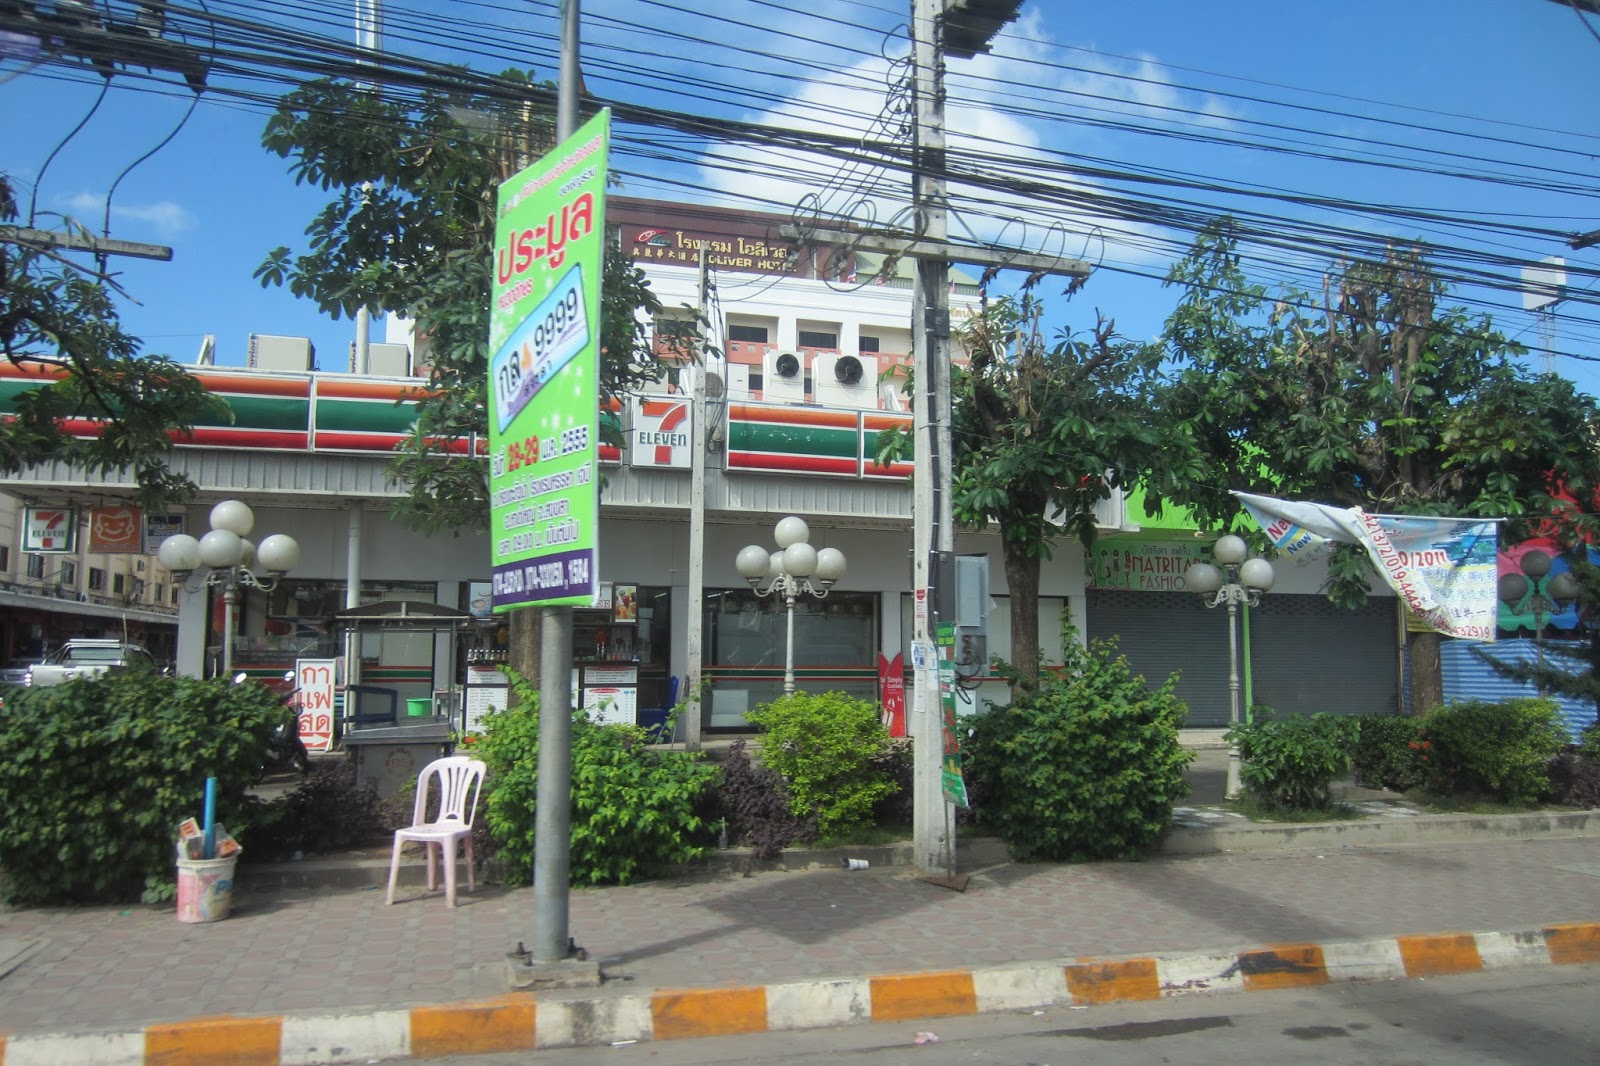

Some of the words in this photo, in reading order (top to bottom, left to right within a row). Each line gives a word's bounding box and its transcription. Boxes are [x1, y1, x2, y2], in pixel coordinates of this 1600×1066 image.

[497, 192, 594, 286] ประมูล
[676, 231, 732, 253] โรงรม
[534, 286, 578, 357] 9999
[1267, 517, 1291, 541] Ne
[1287, 532, 1312, 555] New
[1140, 575, 1189, 591] FASHIO
